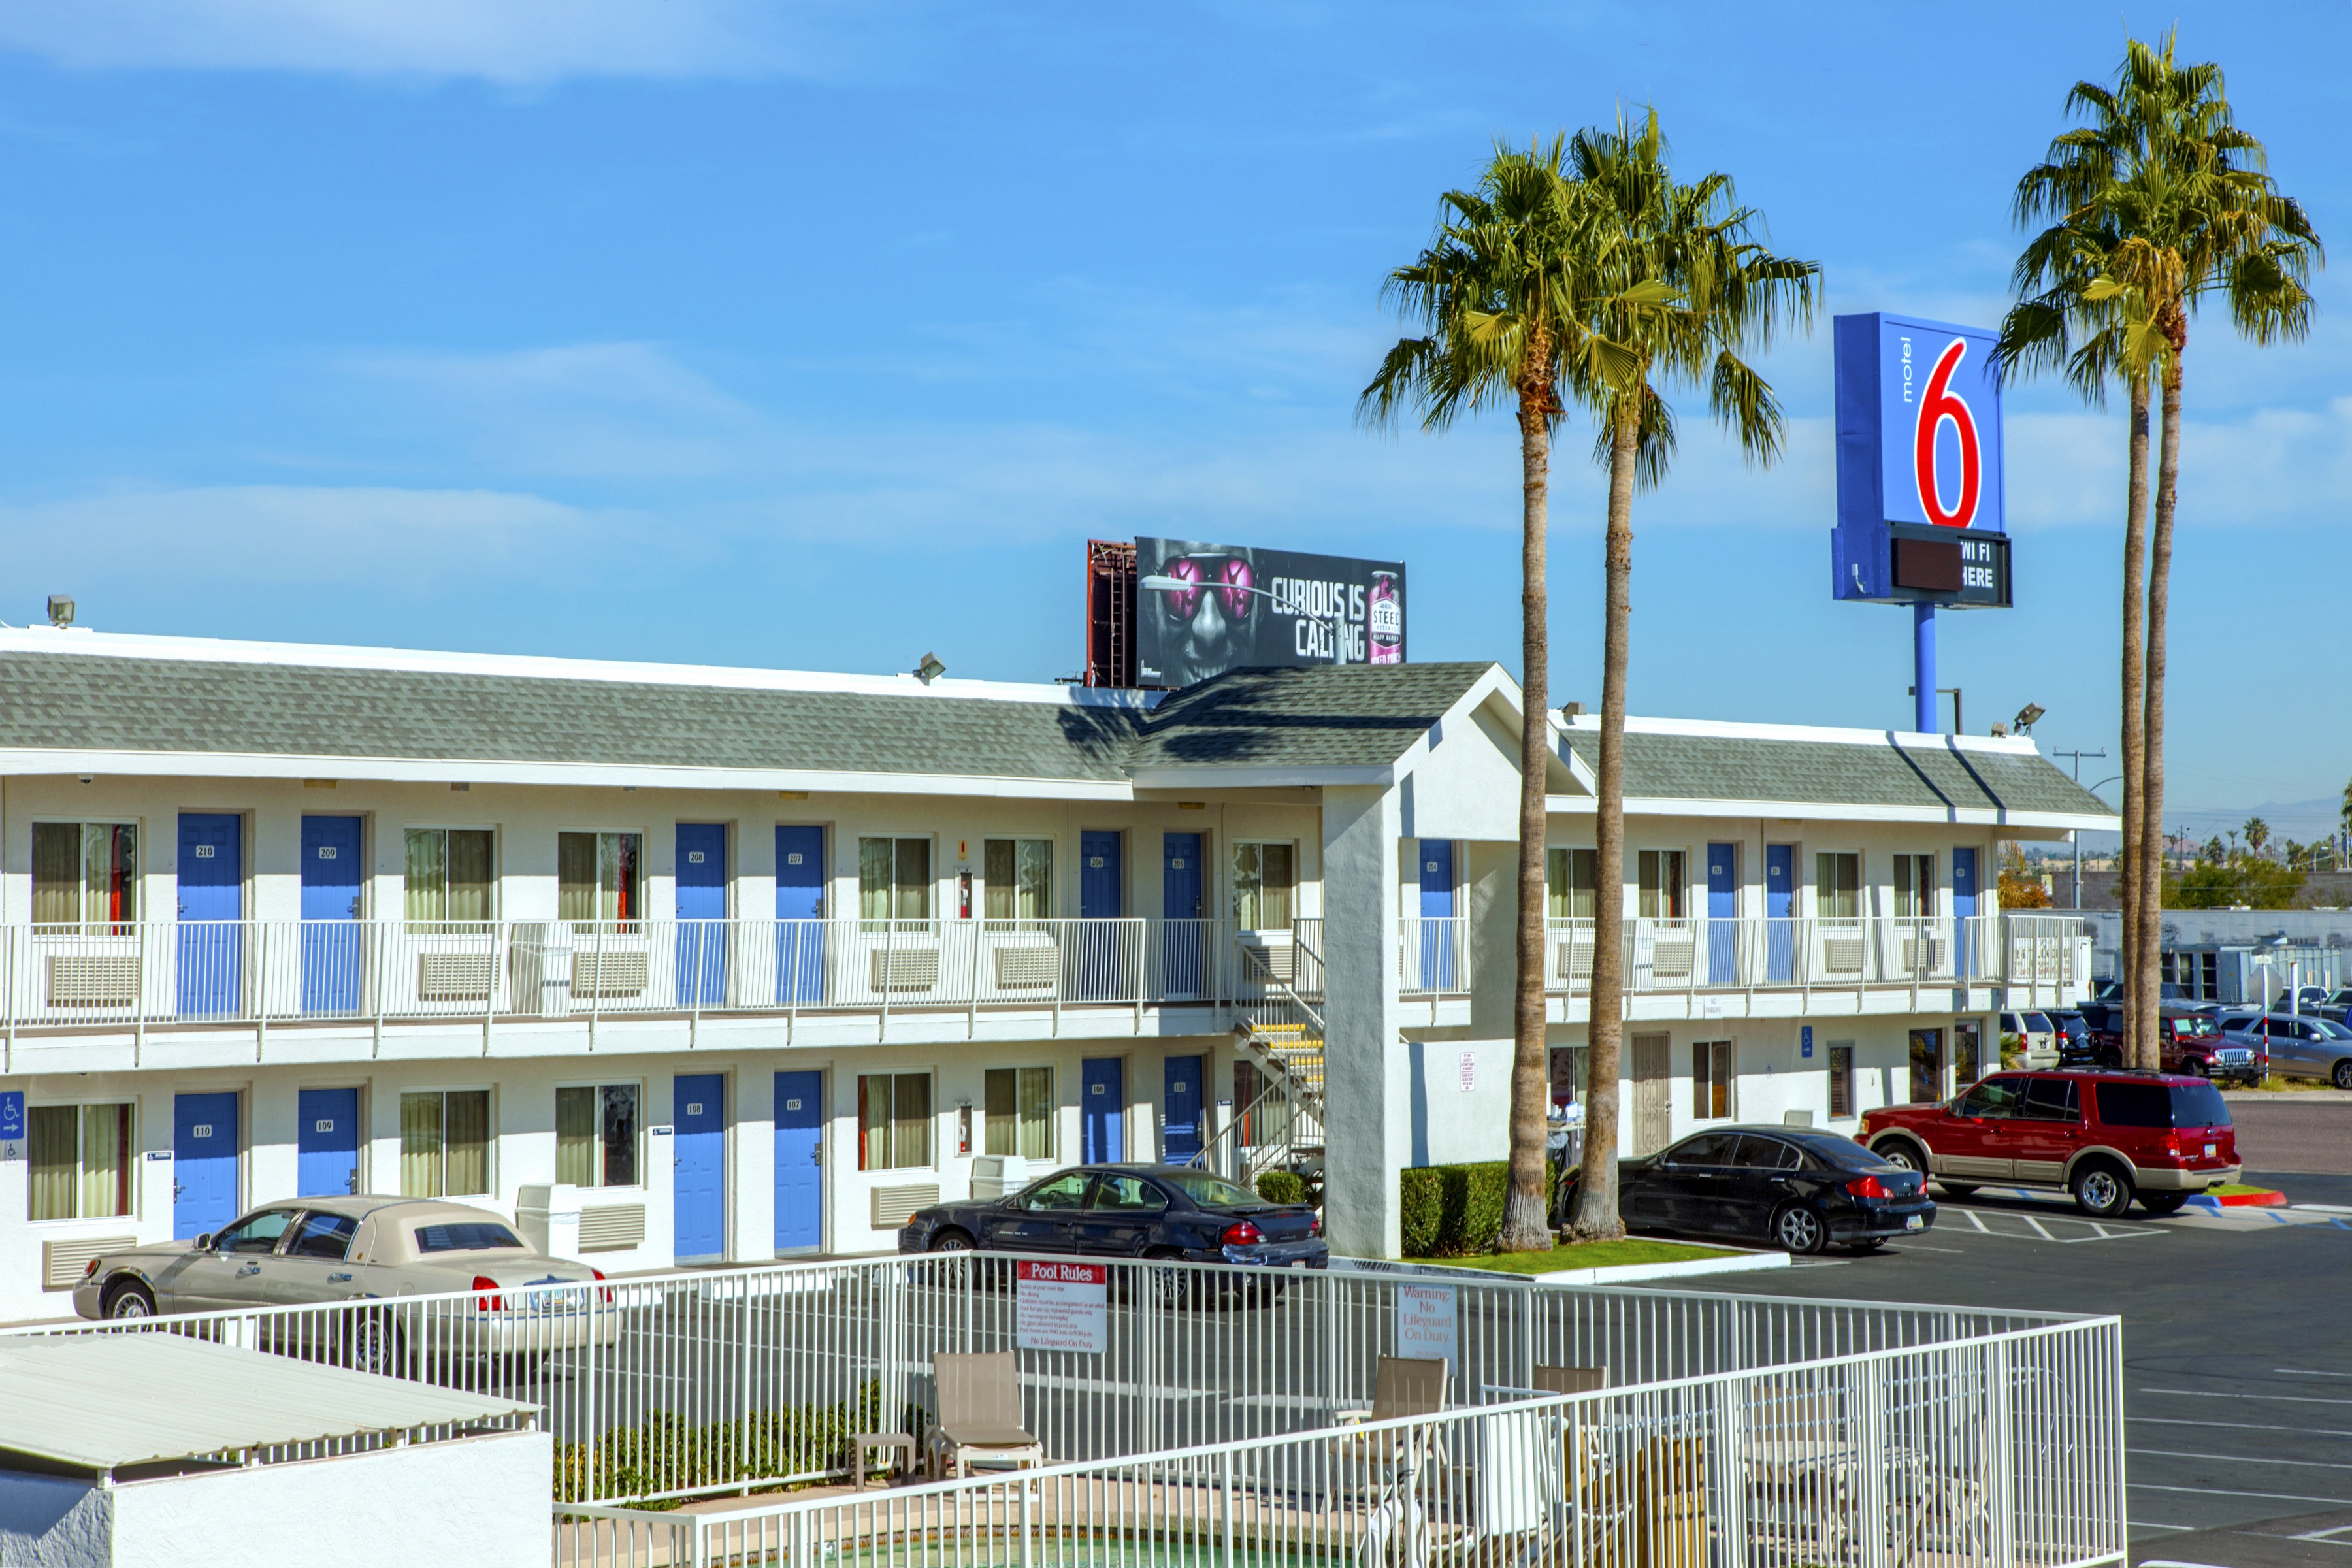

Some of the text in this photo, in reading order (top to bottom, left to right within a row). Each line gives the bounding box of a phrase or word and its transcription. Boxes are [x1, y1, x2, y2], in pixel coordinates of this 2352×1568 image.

[1901, 337, 1912, 402] motel
[1914, 336, 1982, 529] 6
[1960, 540, 1990, 562] WI FI
[1271, 577, 1365, 622] CURIOUS IS
[1373, 610, 1399, 626] STEEL
[1296, 619, 1365, 661] CALLNG
[199, 847, 212, 856] 210
[321, 849, 335, 857] 209
[689, 1105, 700, 1113] 108
[197, 1127, 210, 1135] 110
[319, 1122, 331, 1130] 109
[1031, 1263, 1092, 1281] Pool Rules
[1403, 1286, 1450, 1303] Warning:
[1420, 1301, 1435, 1313] No
[1403, 1313, 1452, 1330] Lifeguard
[1405, 1328, 1421, 1340] On
[1041, 1337, 1066, 1347] Lifeguard
[1079, 1339, 1092, 1349] Duty
